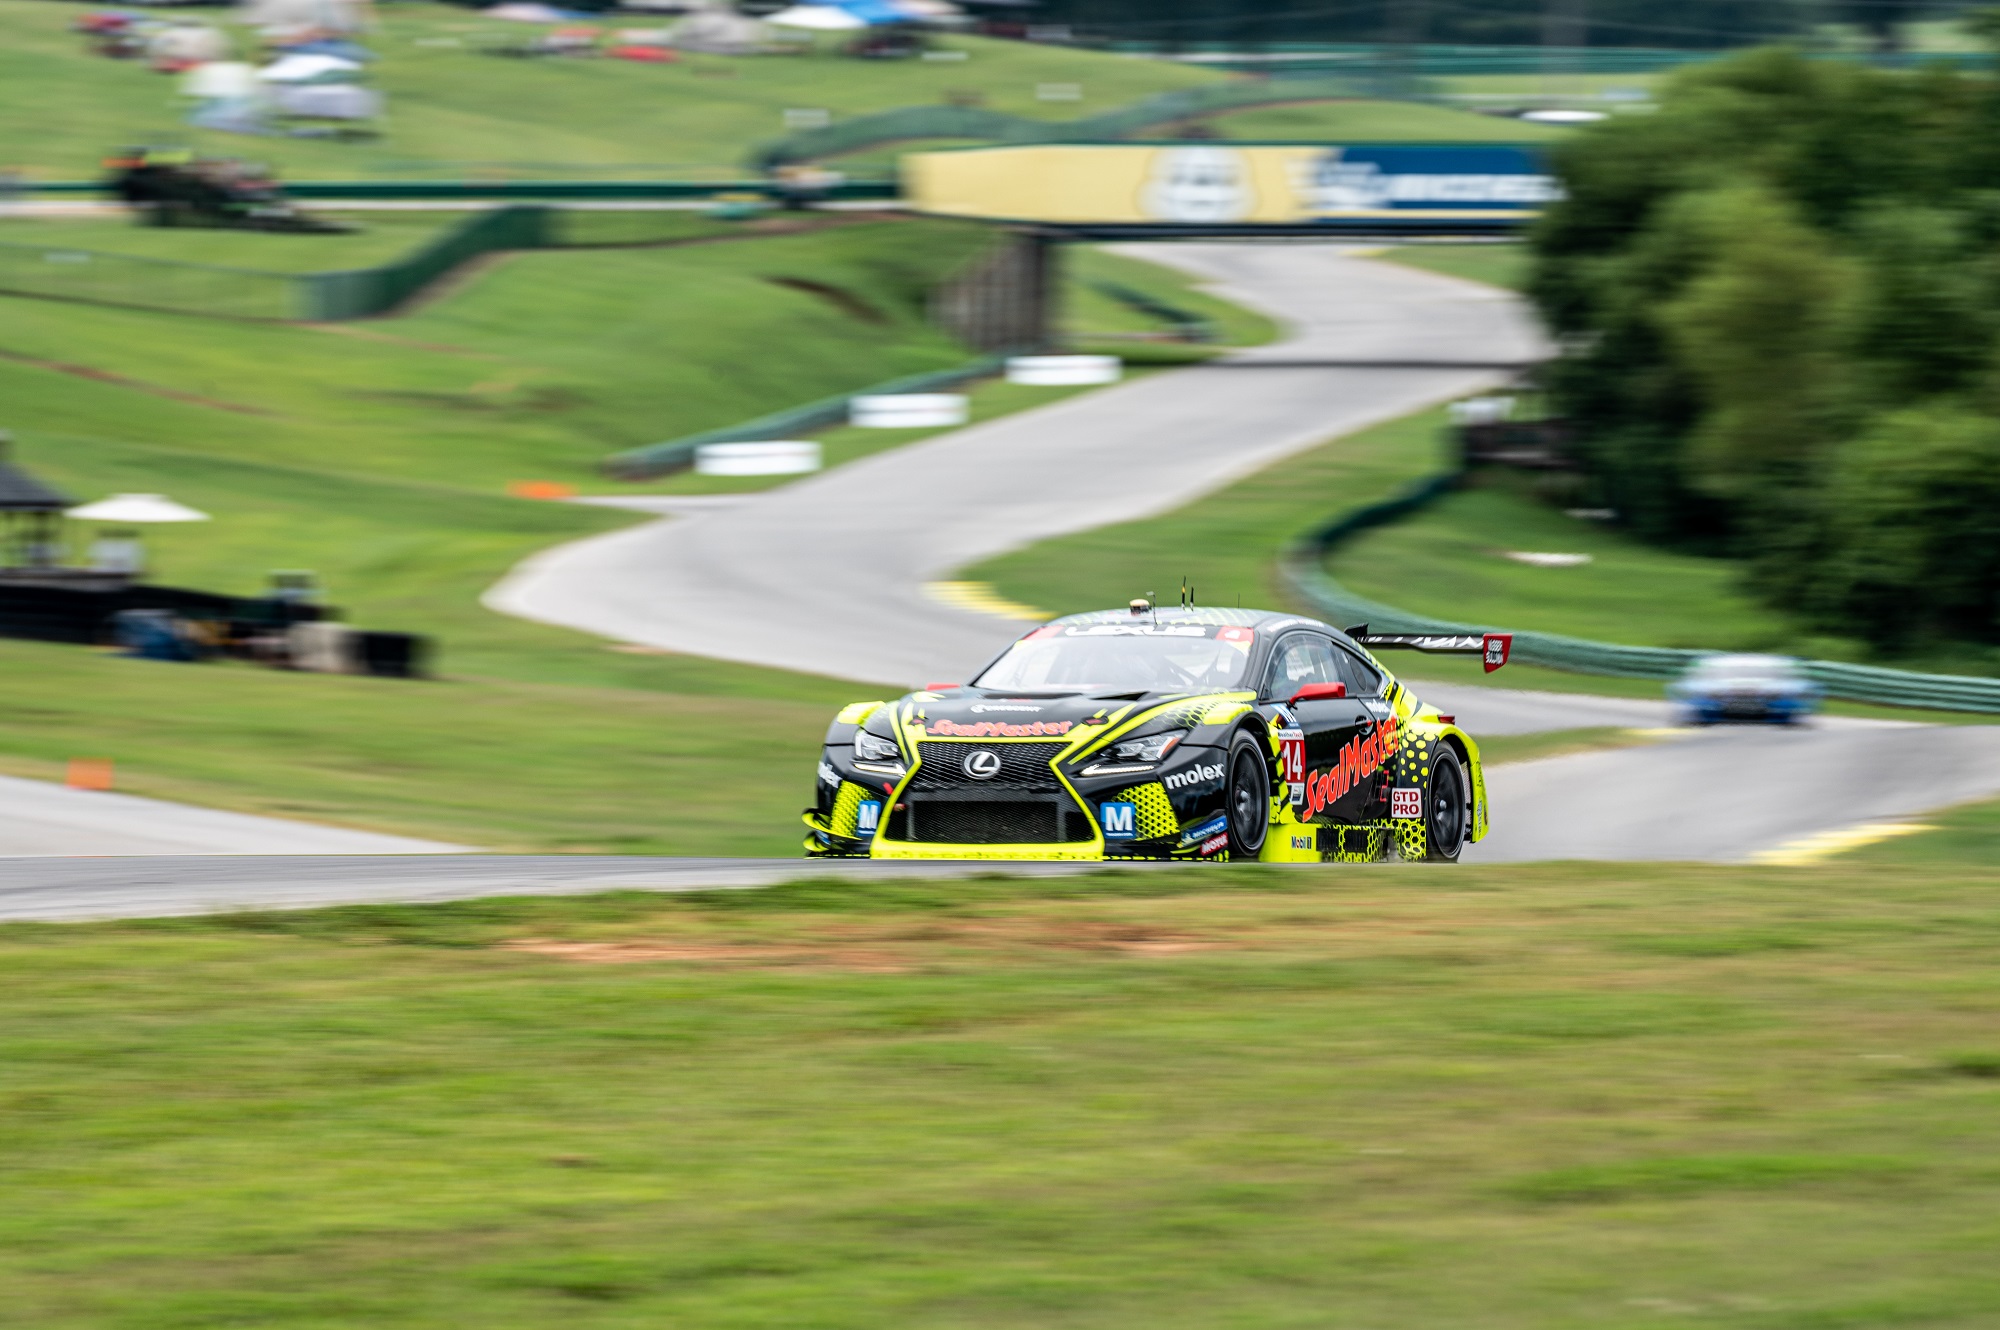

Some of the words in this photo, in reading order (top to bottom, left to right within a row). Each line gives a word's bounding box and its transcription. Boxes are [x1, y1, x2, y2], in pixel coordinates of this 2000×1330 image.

[1065, 625, 1206, 637] LEXUS
[926, 719, 1073, 737] SealMaster
[1283, 741, 1303, 781] 14
[1302, 715, 1399, 823] SealMaster
[1164, 763, 1225, 790] molex
[1393, 791, 1419, 803] GTD
[1393, 803, 1419, 815] PRO
[1105, 806, 1133, 831] M
[1291, 835, 1306, 849] Mobil
